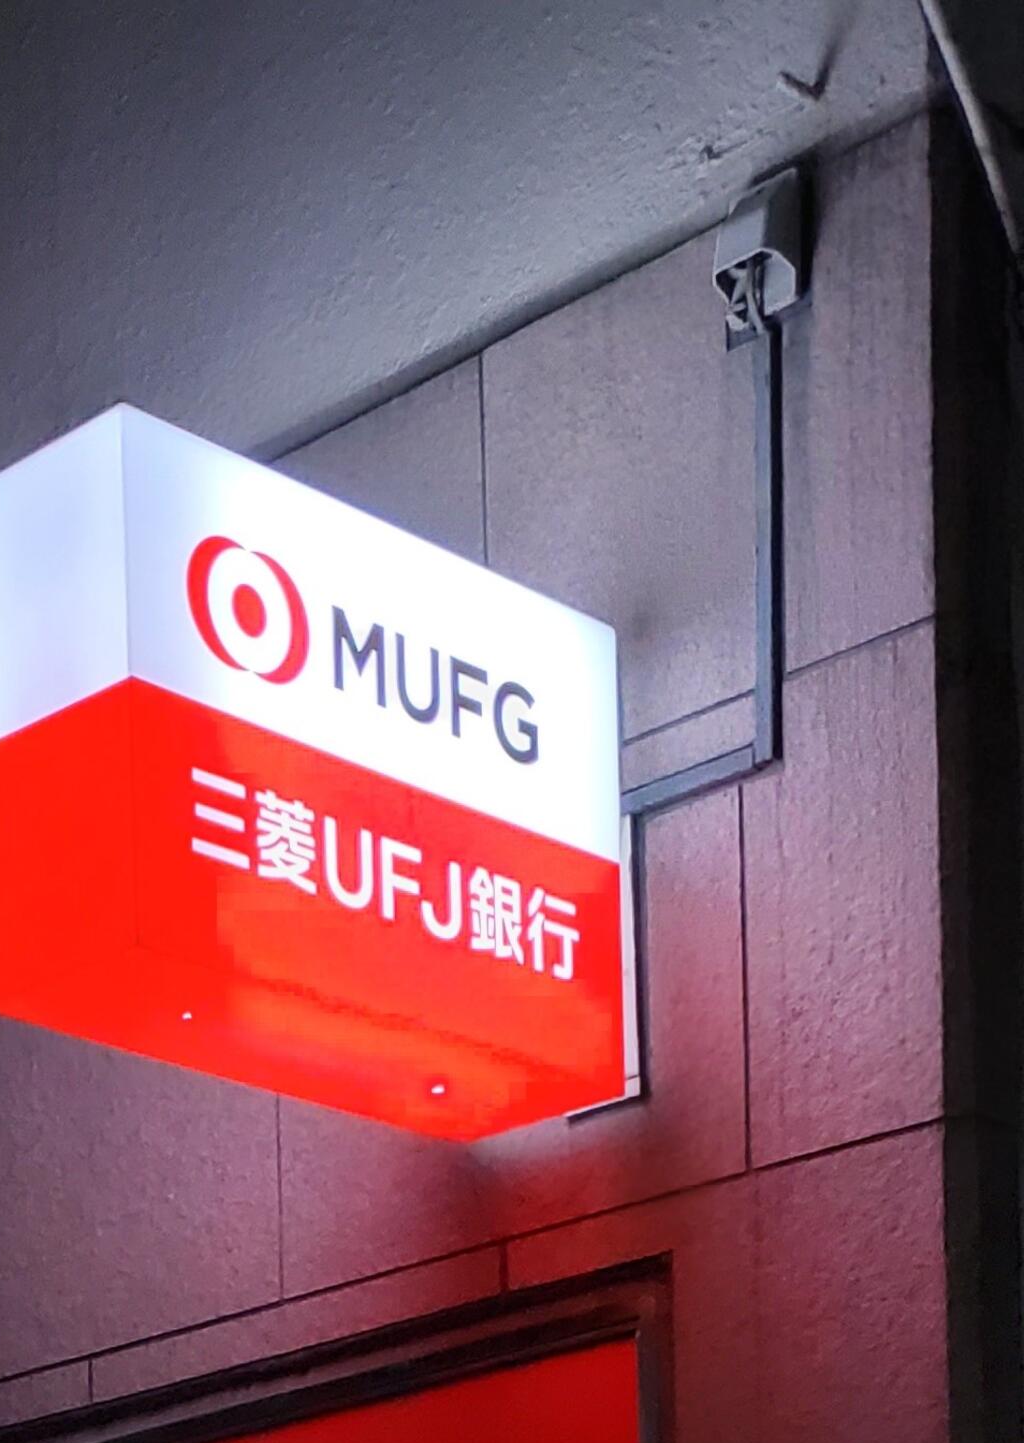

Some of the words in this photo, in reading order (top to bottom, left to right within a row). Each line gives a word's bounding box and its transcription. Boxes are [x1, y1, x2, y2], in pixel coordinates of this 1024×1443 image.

[332, 605, 539, 764] MUFG
[191, 767, 580, 981] 三菱UFJ銀行
